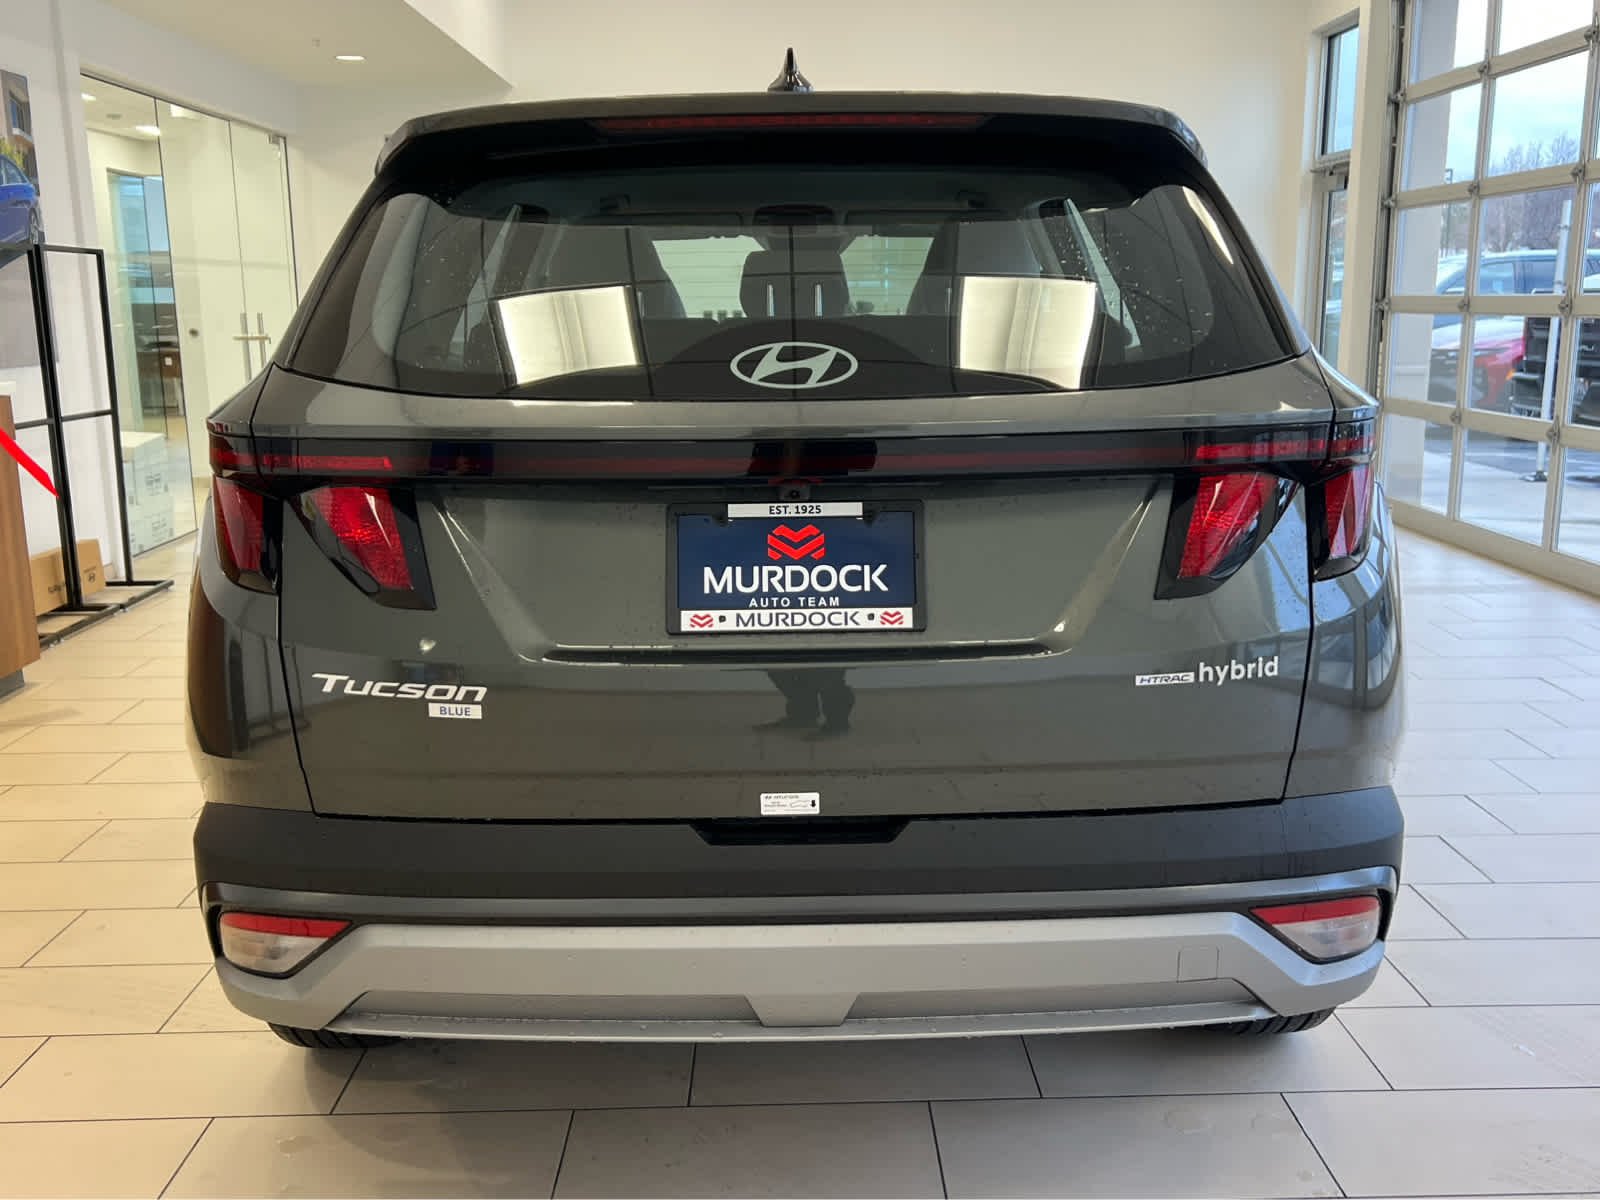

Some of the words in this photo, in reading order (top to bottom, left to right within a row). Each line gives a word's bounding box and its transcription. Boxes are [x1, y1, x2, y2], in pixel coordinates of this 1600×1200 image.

[768, 505, 792, 515] EST.
[794, 504, 822, 514] 1925
[703, 564, 889, 594] MURDOCK
[749, 597, 791, 608] AUTO
[798, 596, 840, 607] TEAM
[735, 611, 861, 628] MURDOCK
[1198, 656, 1279, 687] hybrid
[439, 706, 471, 717] BLUE
